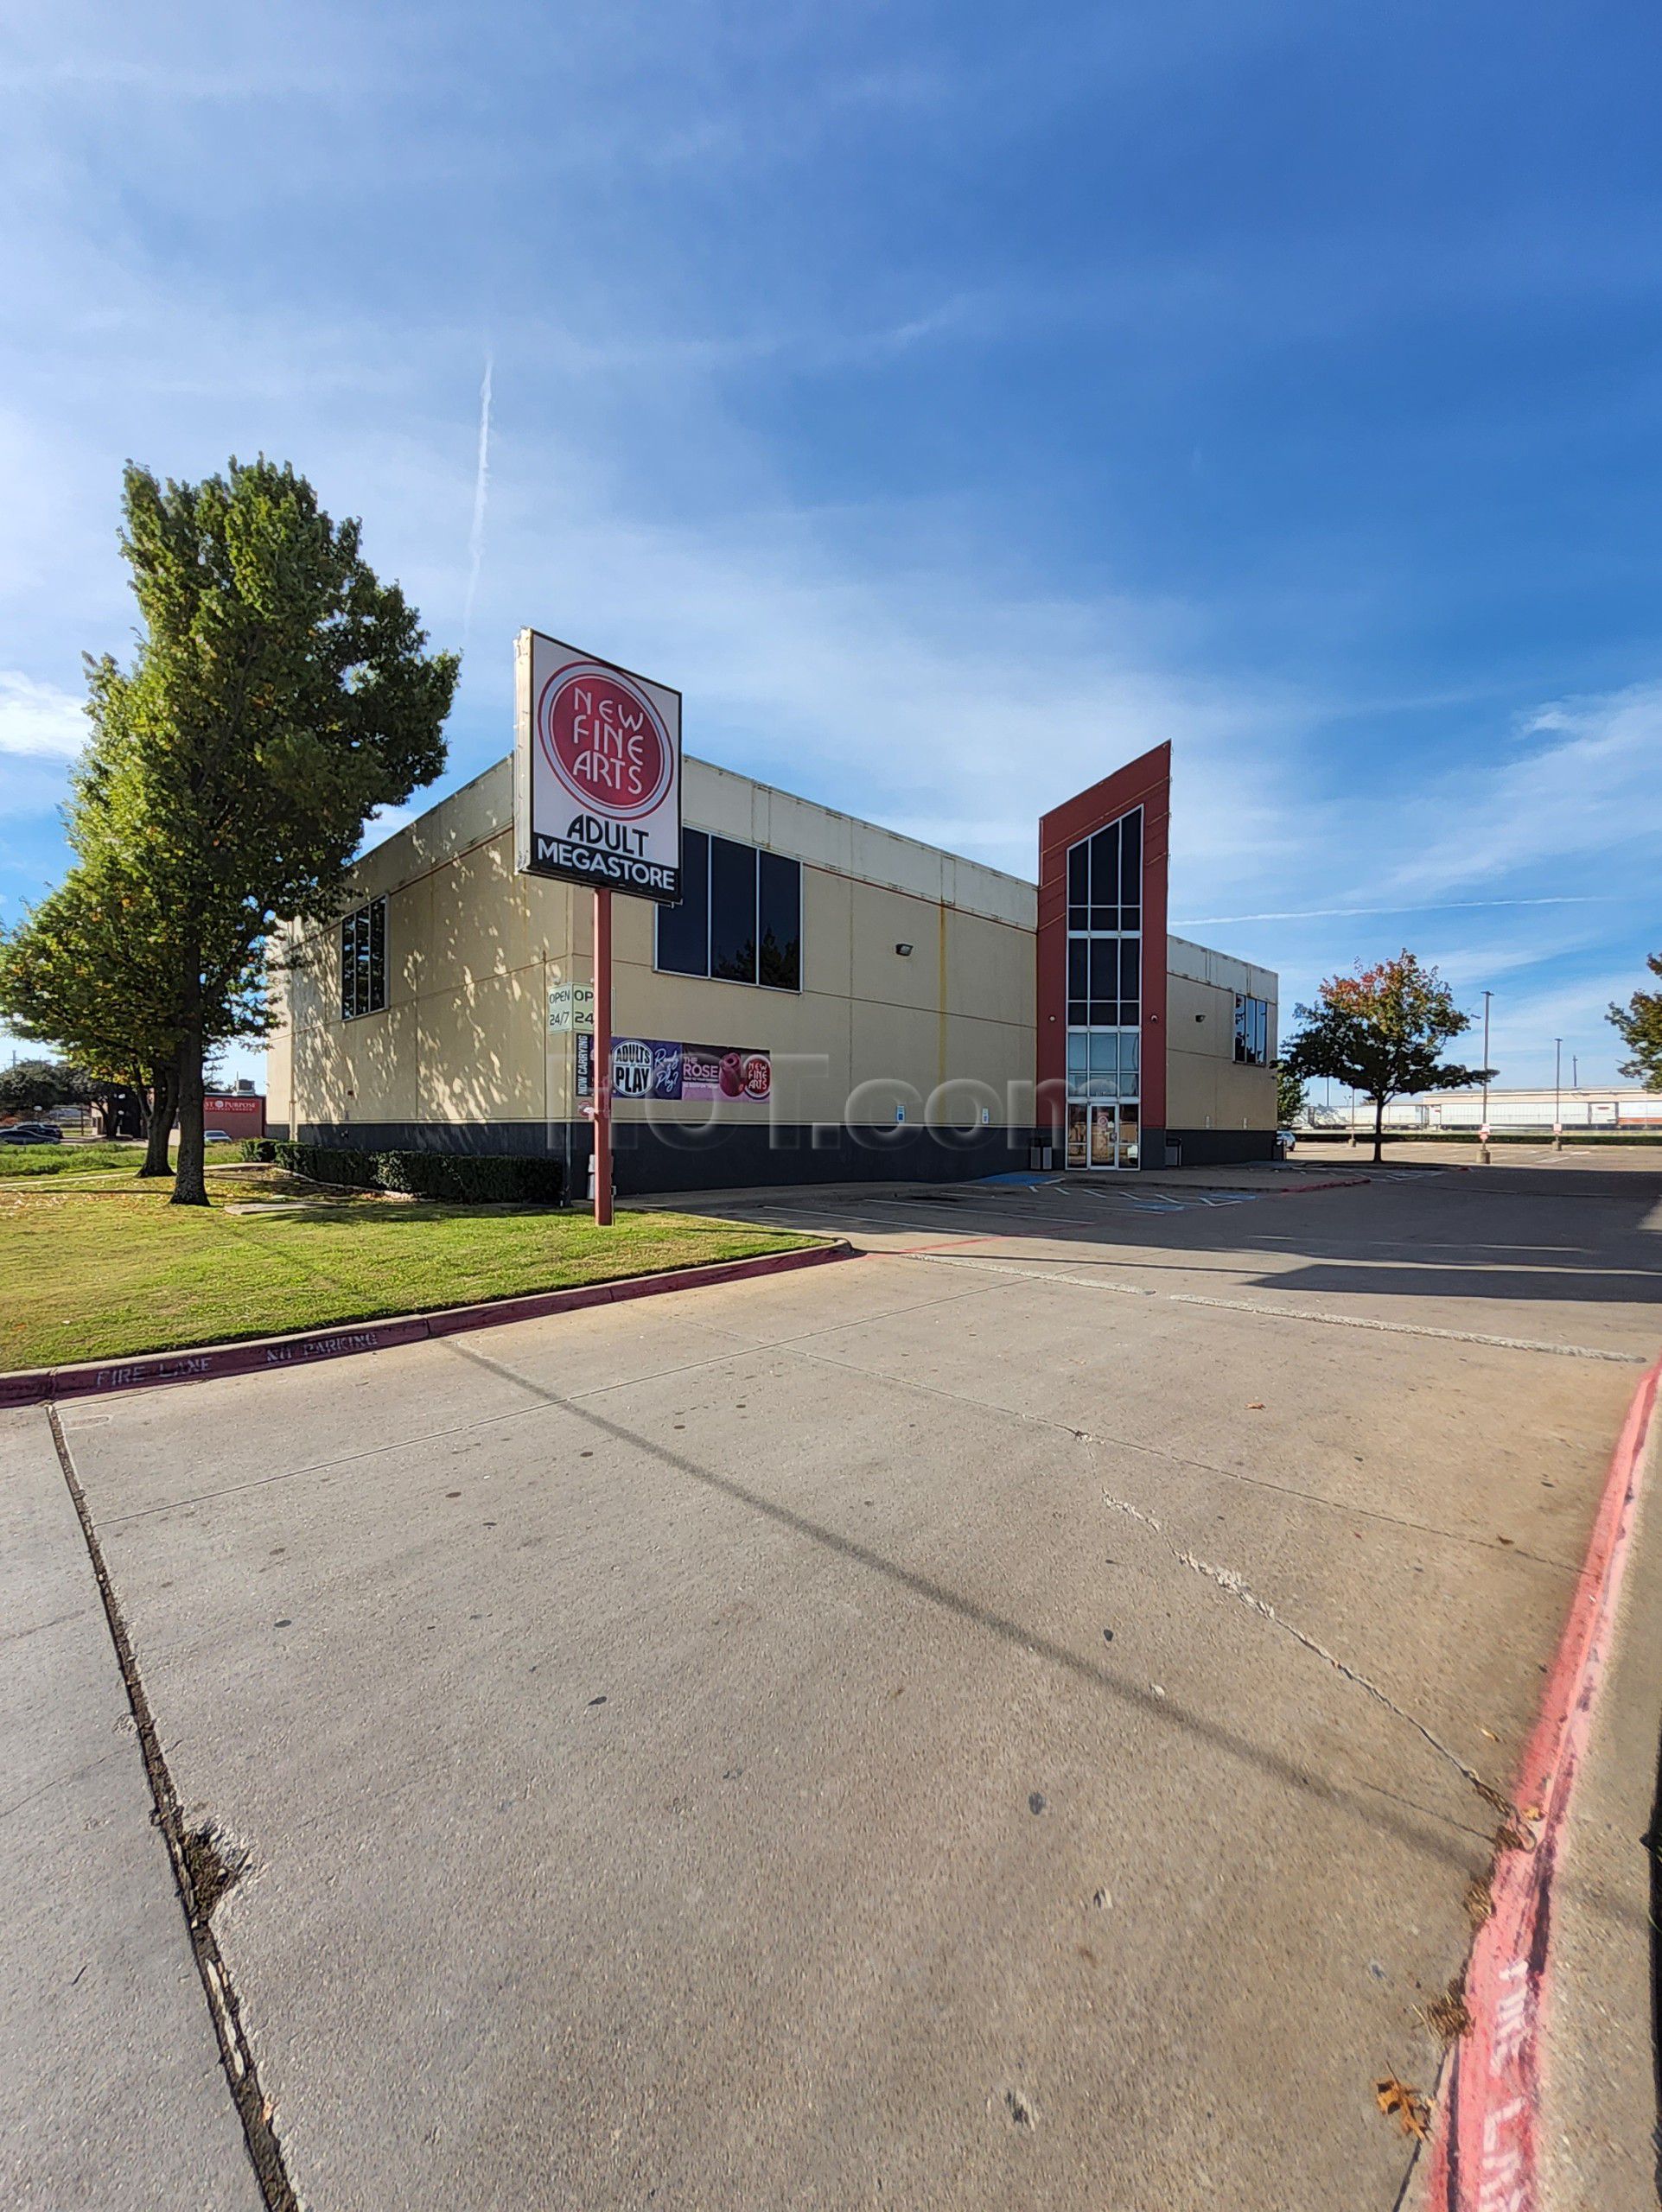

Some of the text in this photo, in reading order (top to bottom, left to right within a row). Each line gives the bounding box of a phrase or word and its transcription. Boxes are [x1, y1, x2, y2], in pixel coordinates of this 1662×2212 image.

[574, 687, 644, 732] NEW
[574, 714, 644, 766] FINE
[572, 750, 642, 795] ARTS
[566, 814, 650, 857] ADULT
[538, 838, 675, 891] MEGASTORE
[550, 990, 570, 1004] OPEN
[574, 989, 594, 1002] OP
[550, 1011, 570, 1026] 24/7
[574, 1011, 594, 1025] 24
[615, 1044, 650, 1064] ADULTS
[654, 1048, 679, 1071] Ready
[684, 1056, 698, 1065] THE
[577, 1035, 588, 1095] NOW CARRYING
[683, 1064, 719, 1078] ROSE
[748, 1062, 767, 1071] NEW
[748, 1070, 767, 1080] FINE
[615, 1066, 650, 1093] PLAY
[656, 1071, 679, 1093] Play?
[748, 1079, 767, 1090] ARTS
[96, 1365, 146, 1388] FIRE
[303, 1333, 378, 1356] PARKING
